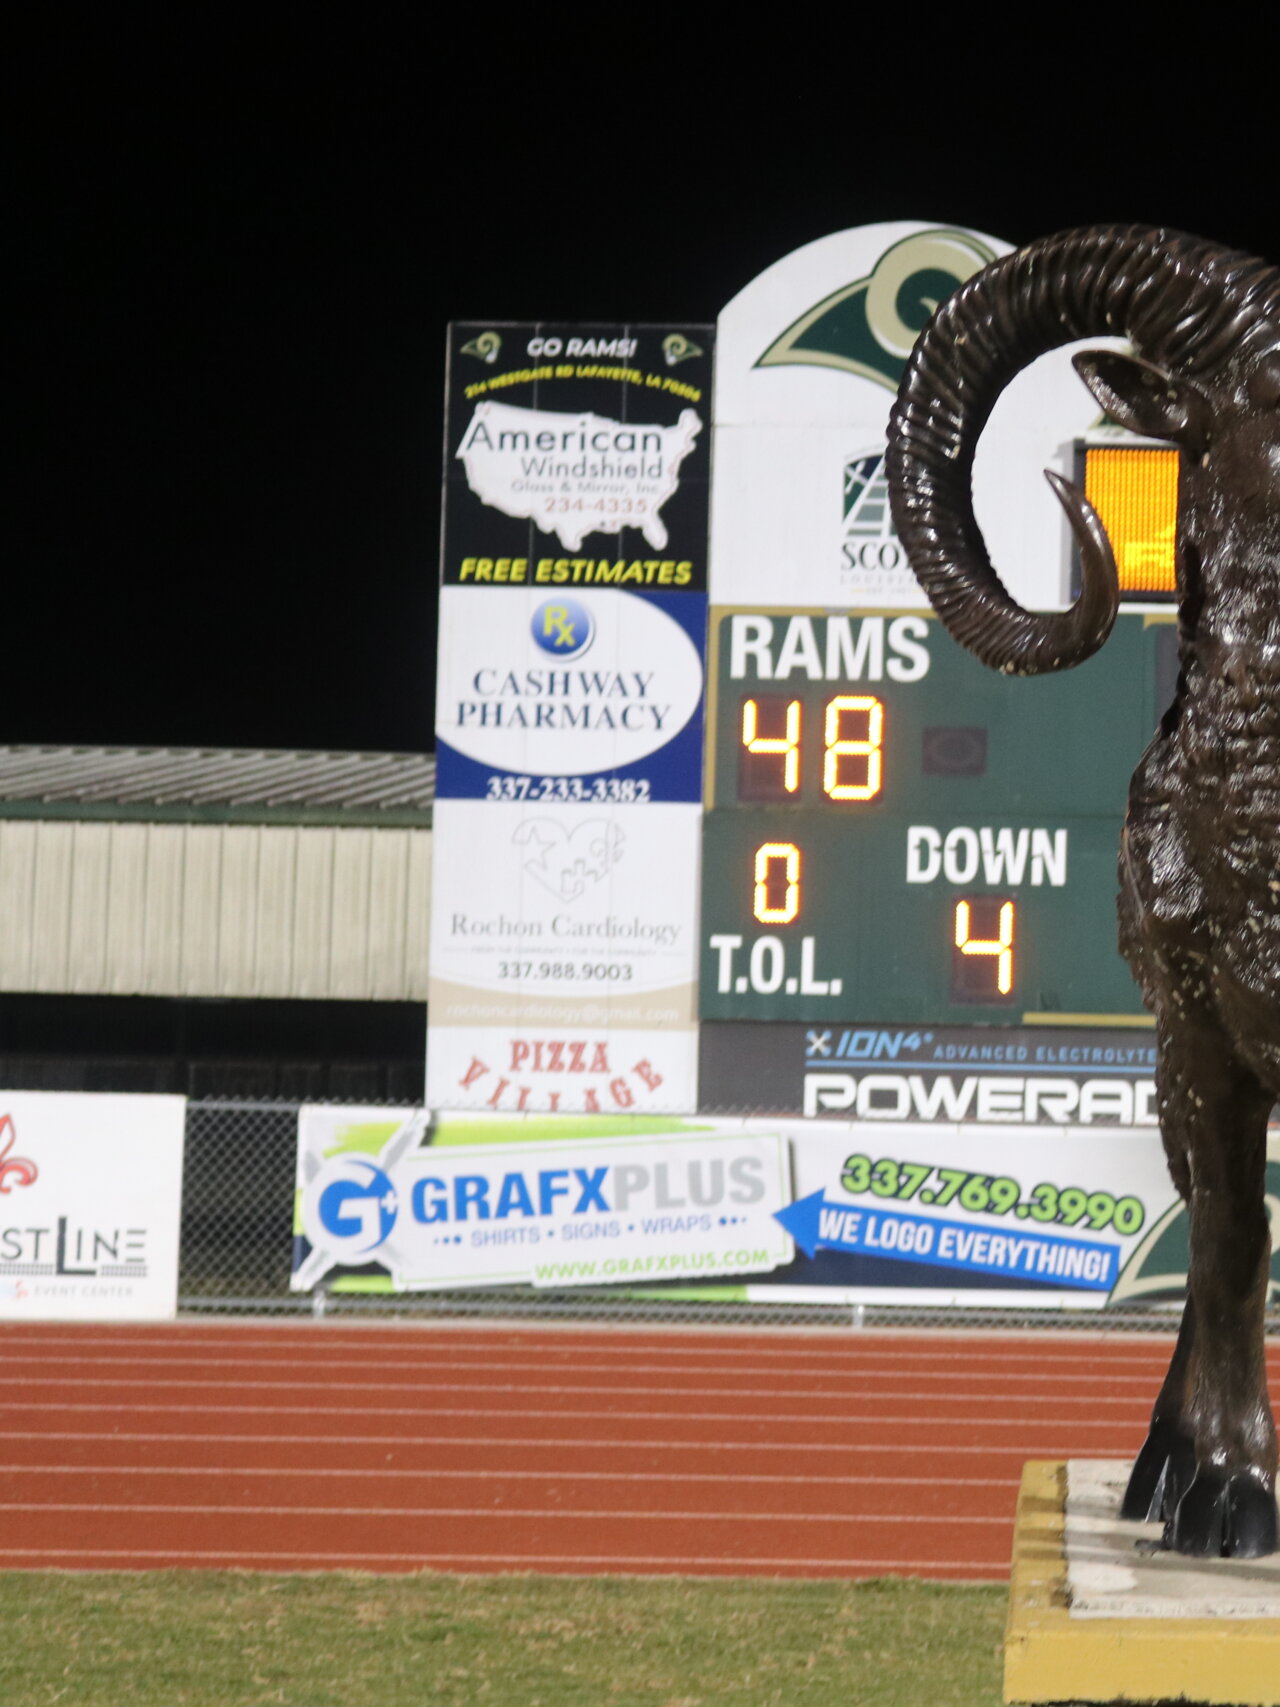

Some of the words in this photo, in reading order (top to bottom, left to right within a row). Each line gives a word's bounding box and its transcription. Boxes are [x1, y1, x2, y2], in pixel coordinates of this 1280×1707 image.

[527, 338, 560, 357] GO
[565, 338, 638, 358] RAMS!
[646, 373, 661, 389] LA
[466, 420, 662, 452] American
[520, 457, 663, 479] Windshield
[510, 480, 553, 493] Glass
[545, 497, 648, 513] 234-4335
[840, 541, 912, 571] SCO
[459, 558, 528, 582] FREE
[535, 559, 692, 585] ESTIMATES
[730, 615, 930, 682] RAMS
[473, 668, 655, 698] CASHWAY
[457, 701, 670, 731] PHARMACY
[742, 695, 884, 801] 48
[486, 776, 650, 802] 337-233-3382
[905, 826, 1068, 886] DOWN
[753, 842, 800, 924] 0
[451, 913, 543, 938] Rochon
[551, 914, 682, 946] Cardiology
[955, 900, 1015, 996] 4
[498, 961, 633, 981] 337.988.9003
[709, 934, 843, 996] T.O.L.
[509, 1039, 611, 1073] PIZZA
[933, 1044, 1029, 1061] ADVANCED
[840, 1152, 1144, 1236] 337.769.3990
[471, 1226, 541, 1248] SHIRTS
[561, 1221, 621, 1242] SIGNS
[642, 1215, 712, 1236] WRAPS
[817, 1209, 860, 1243] WE
[864, 1215, 934, 1255] LOGO
[937, 1226, 1111, 1281] EVERYTHING!
[535, 1249, 770, 1279] WWW.GRAFXPLUS.COM
